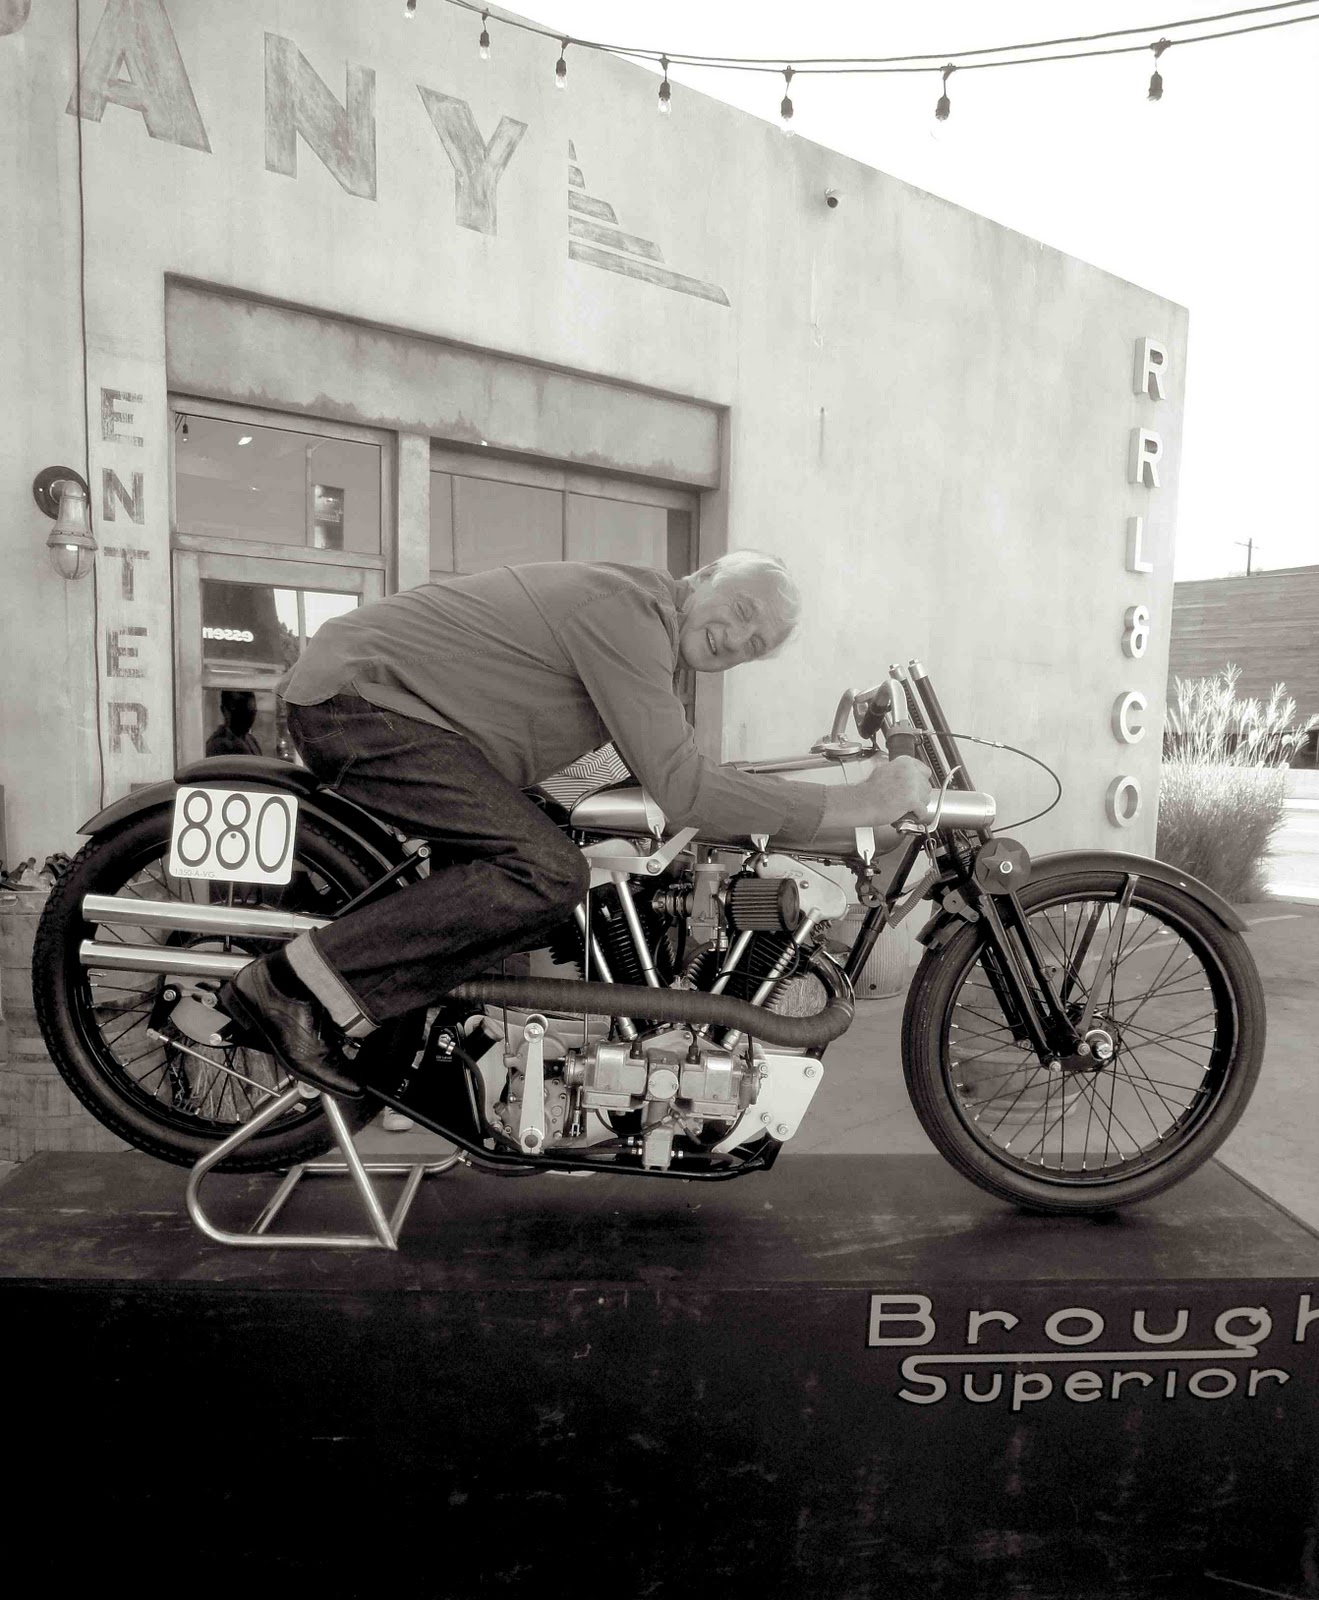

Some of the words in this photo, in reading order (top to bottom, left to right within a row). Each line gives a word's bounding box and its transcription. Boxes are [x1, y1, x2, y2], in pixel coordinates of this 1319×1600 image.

[0, 0, 528, 236] ANY
[100, 387, 152, 755] ENTER
[177, 790, 291, 874] 880
[898, 1354, 1291, 1412] Superior
